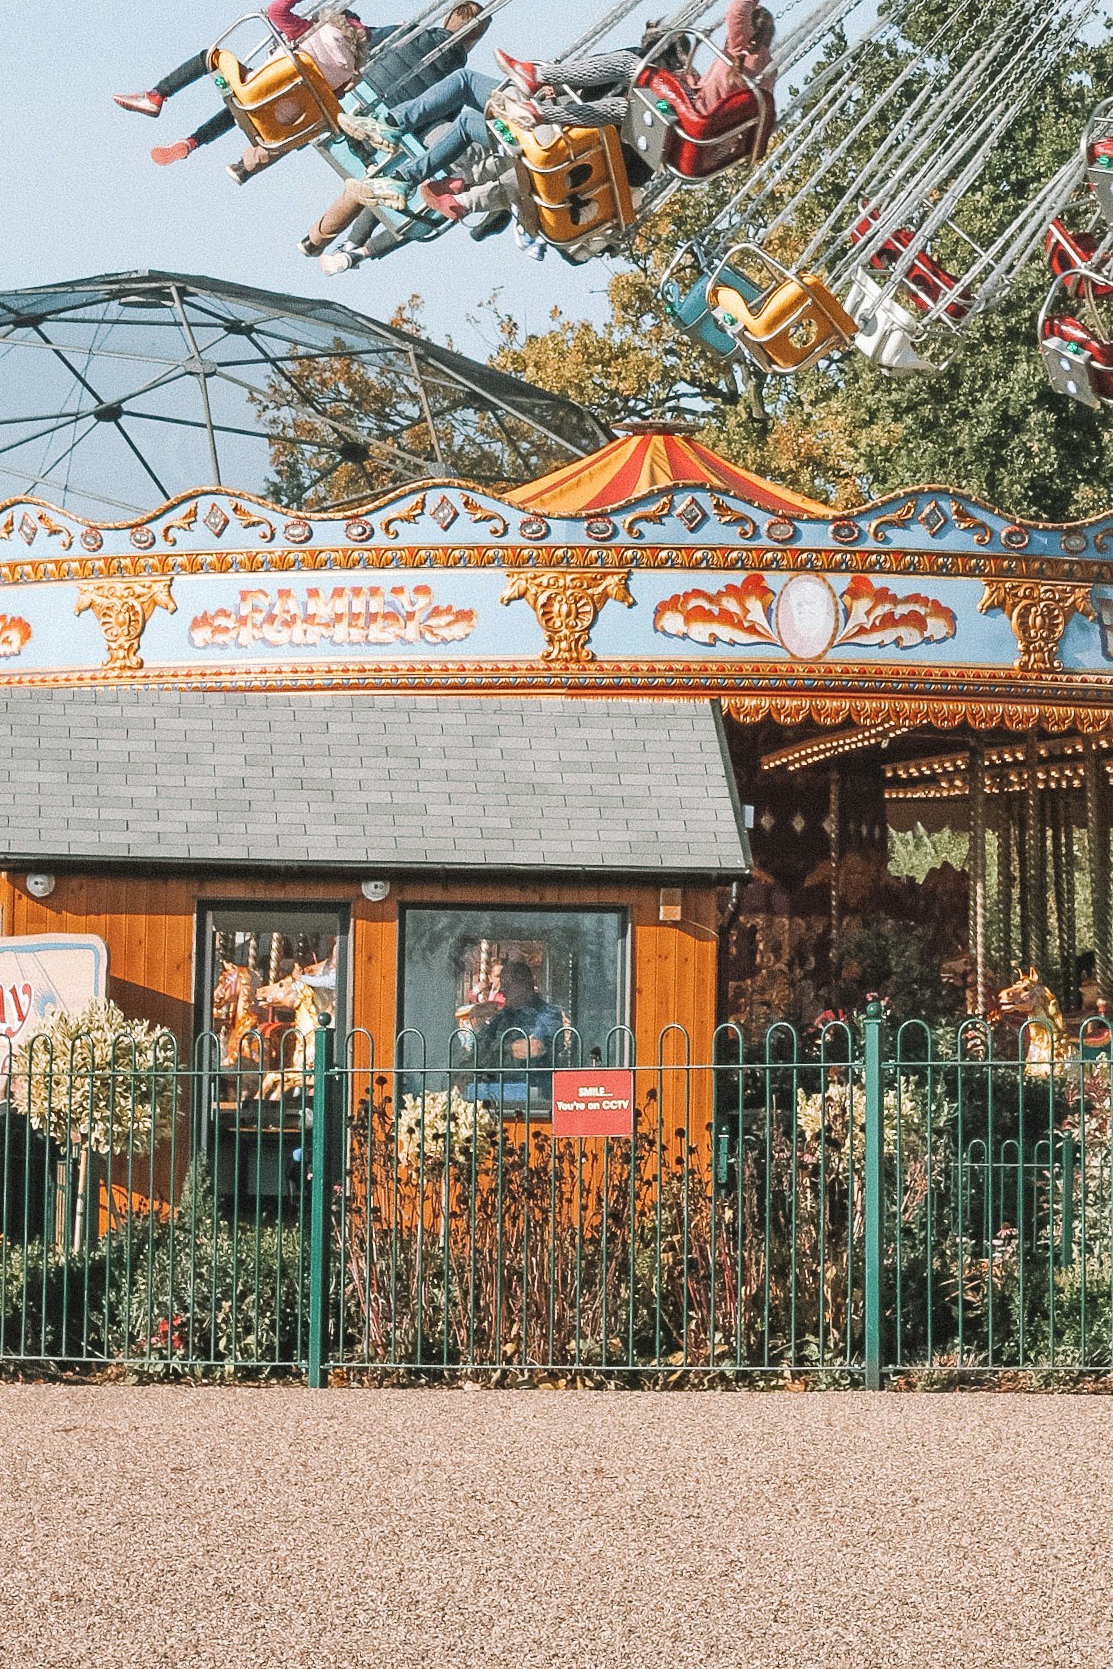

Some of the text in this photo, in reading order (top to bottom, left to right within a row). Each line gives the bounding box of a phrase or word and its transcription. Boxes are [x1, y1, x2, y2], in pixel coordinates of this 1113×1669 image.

[238, 584, 434, 646] FAMILY
[556, 1099, 629, 1111] You're on CCTV
